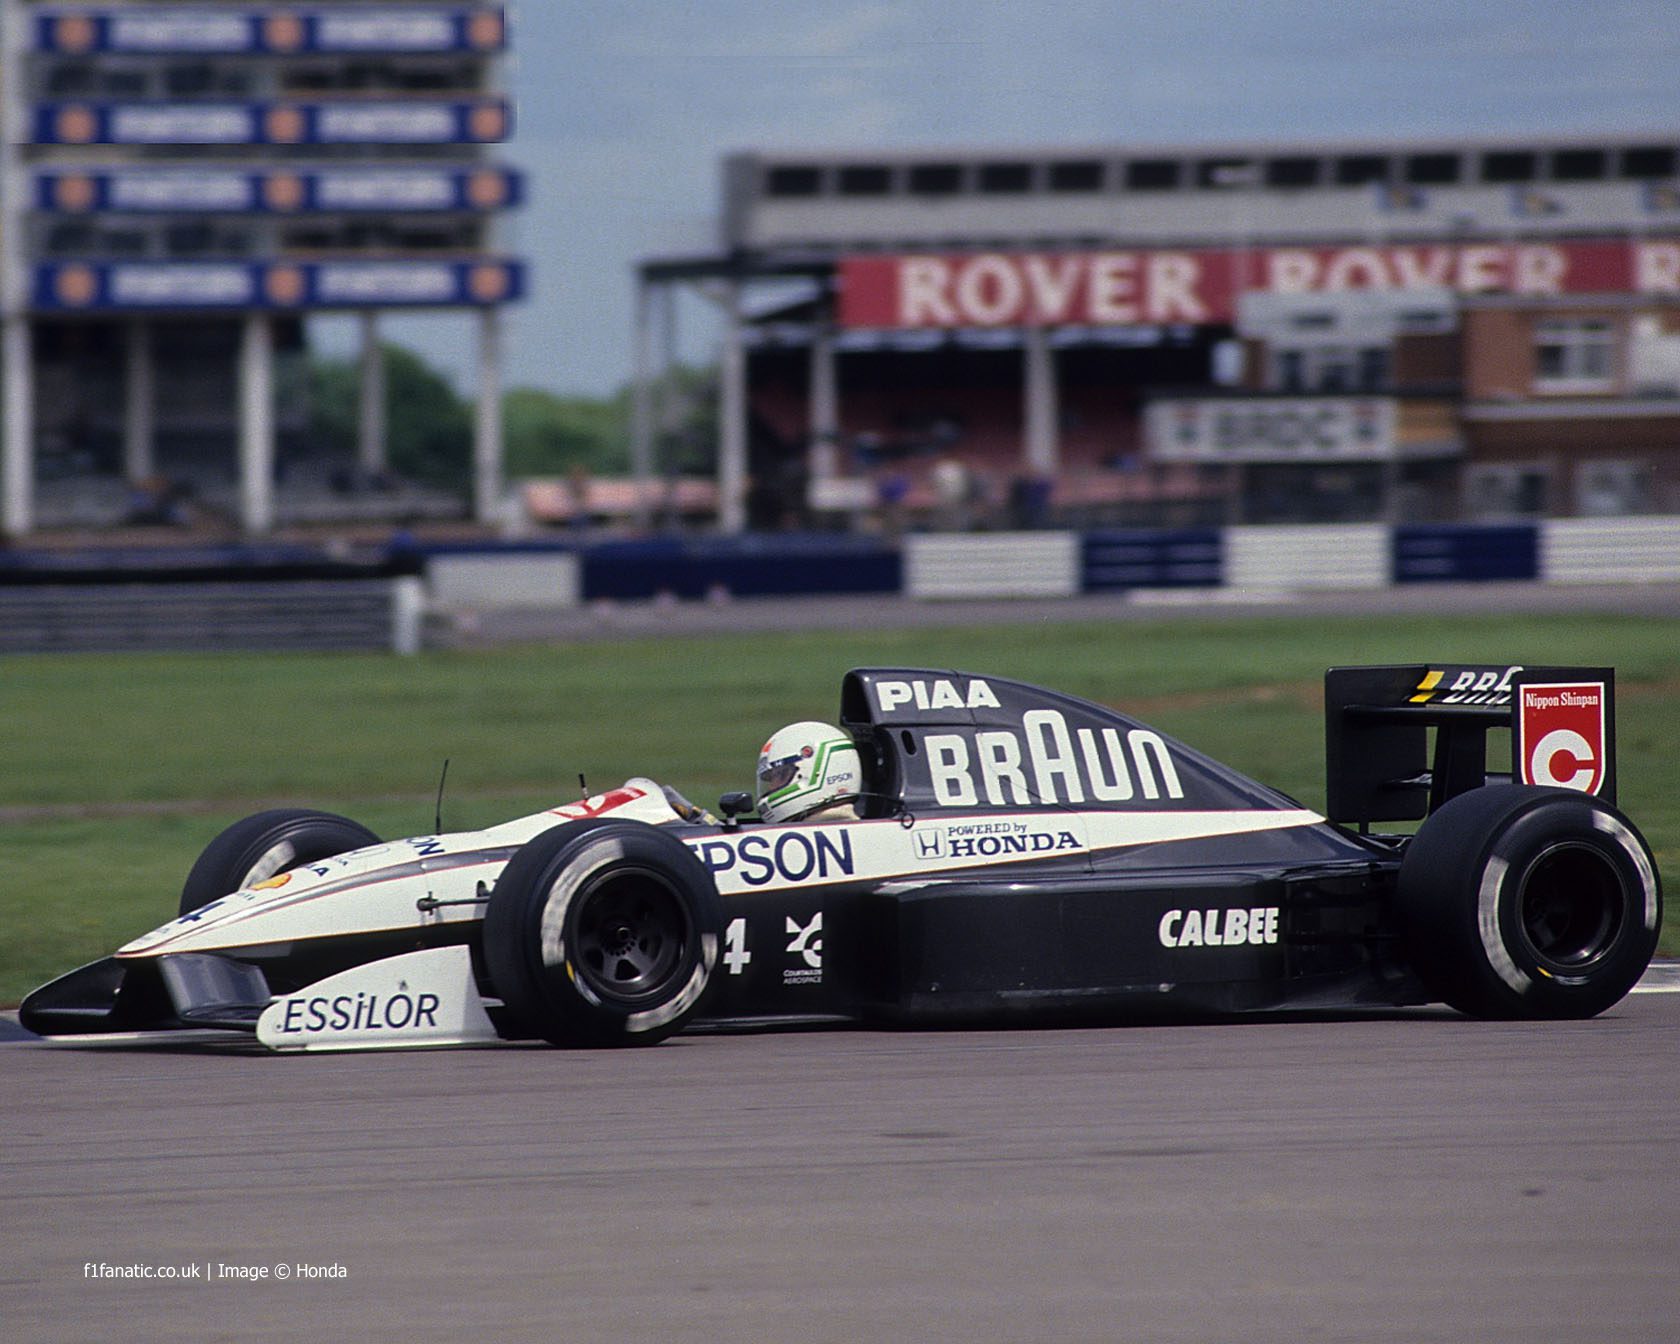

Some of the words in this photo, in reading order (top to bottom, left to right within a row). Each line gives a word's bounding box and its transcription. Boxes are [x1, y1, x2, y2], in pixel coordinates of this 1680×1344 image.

[899, 255, 1206, 325] ROVER
[876, 680, 1001, 711] PIAA
[1526, 693, 1559, 709] Nippon
[1560, 692, 1598, 708] Shinpan
[827, 772, 853, 785] EPSON
[948, 823, 1010, 836] POWERED
[949, 831, 1083, 857] HONDA
[690, 829, 855, 886] PSON
[1159, 907, 1279, 948] CALBEE
[723, 918, 751, 974] 4
